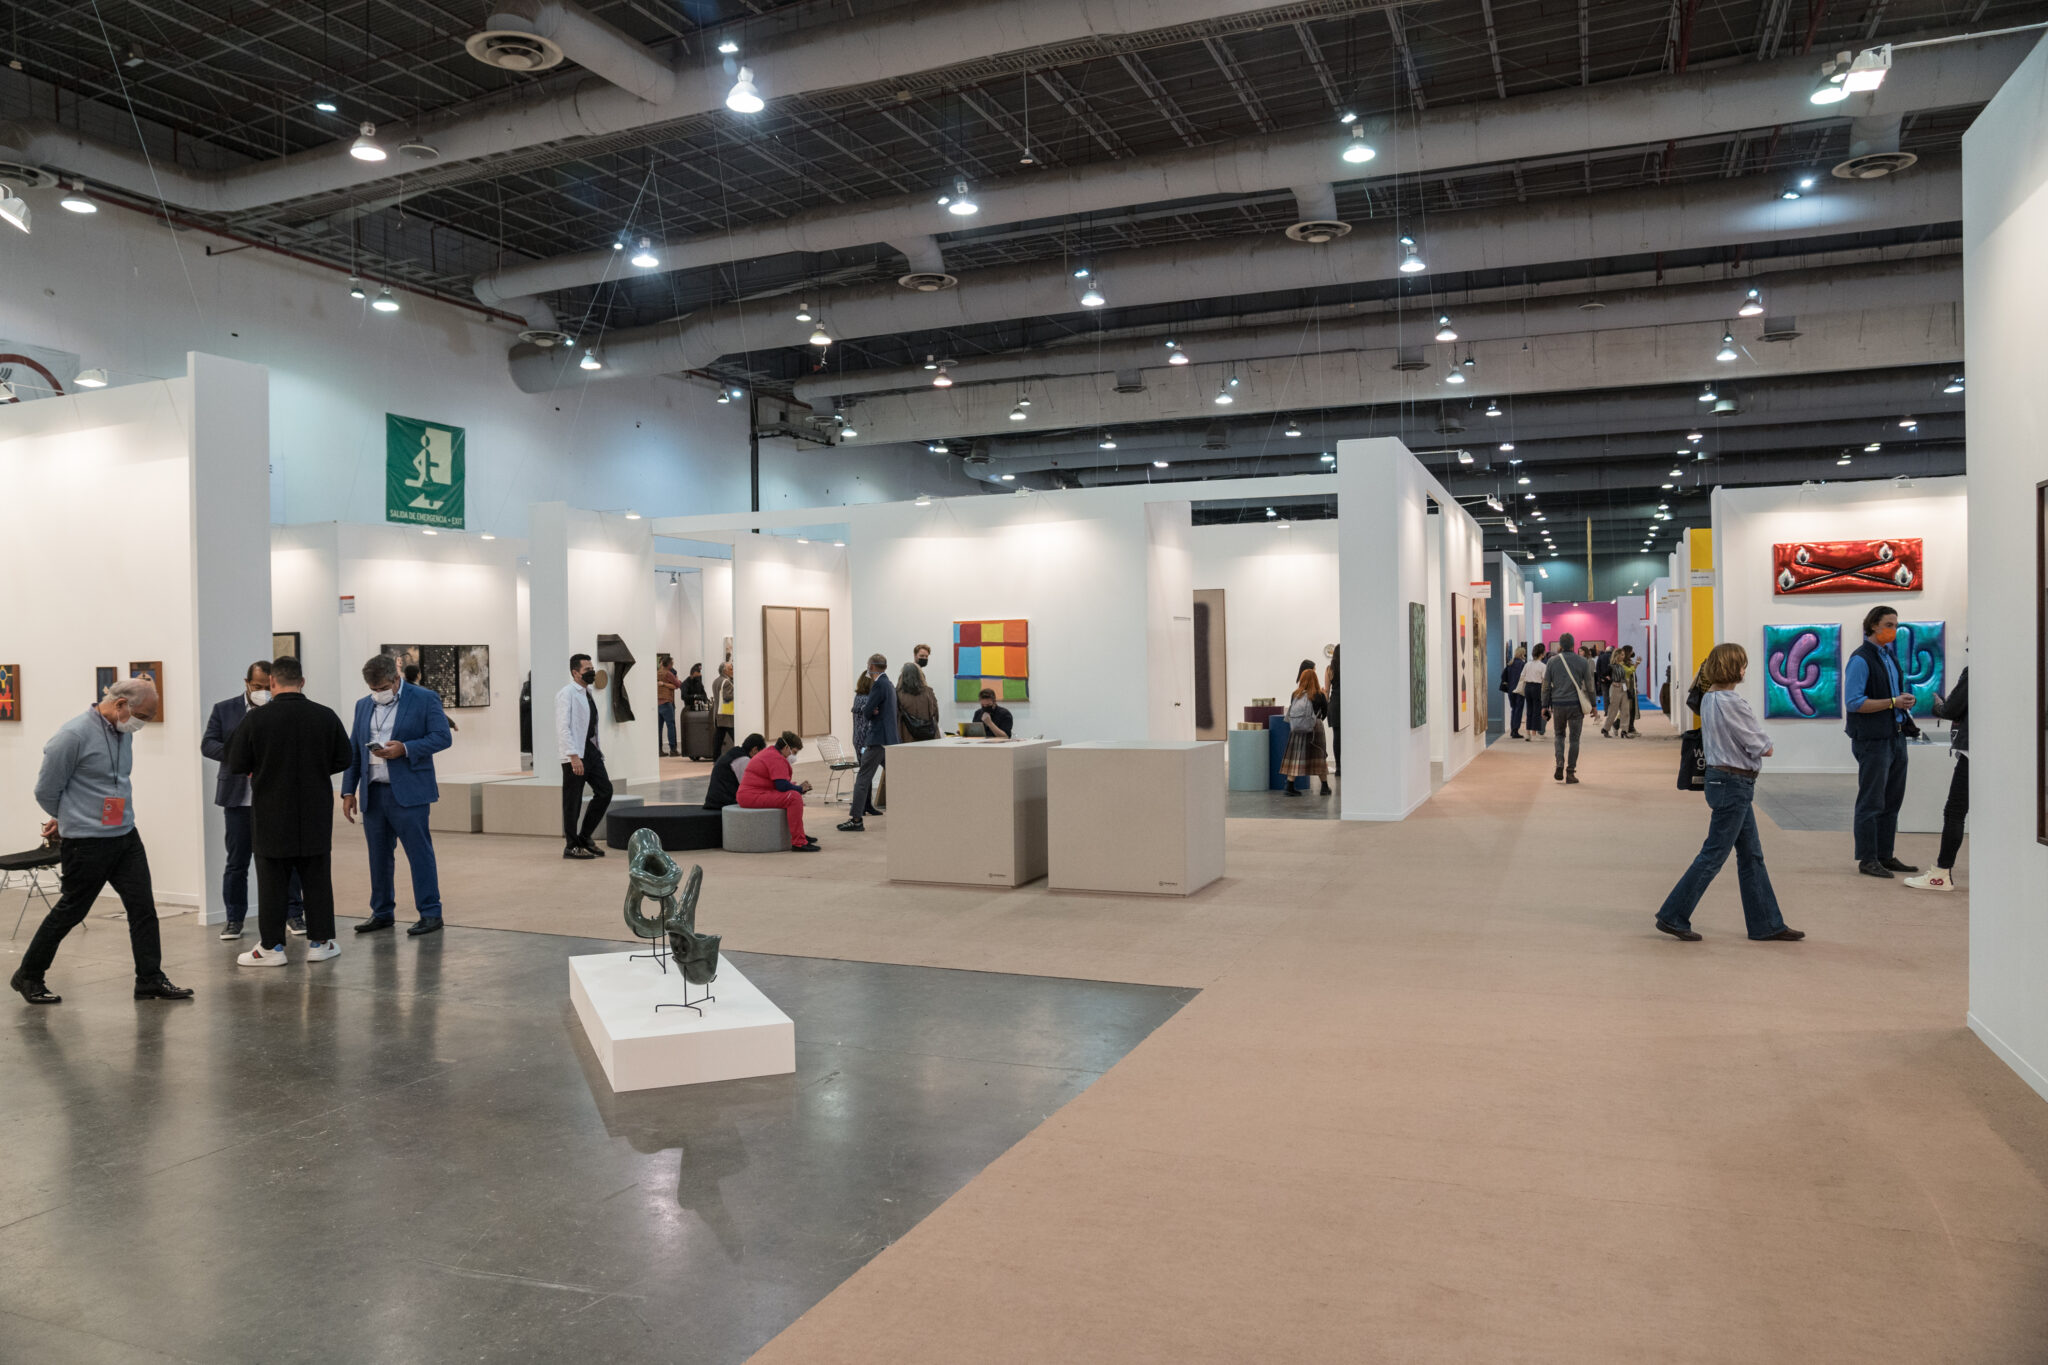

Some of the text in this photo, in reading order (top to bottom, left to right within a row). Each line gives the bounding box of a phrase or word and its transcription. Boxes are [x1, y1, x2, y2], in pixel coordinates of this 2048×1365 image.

[390, 509, 463, 525] SALIDA DE EMERGENCIA EXIT
